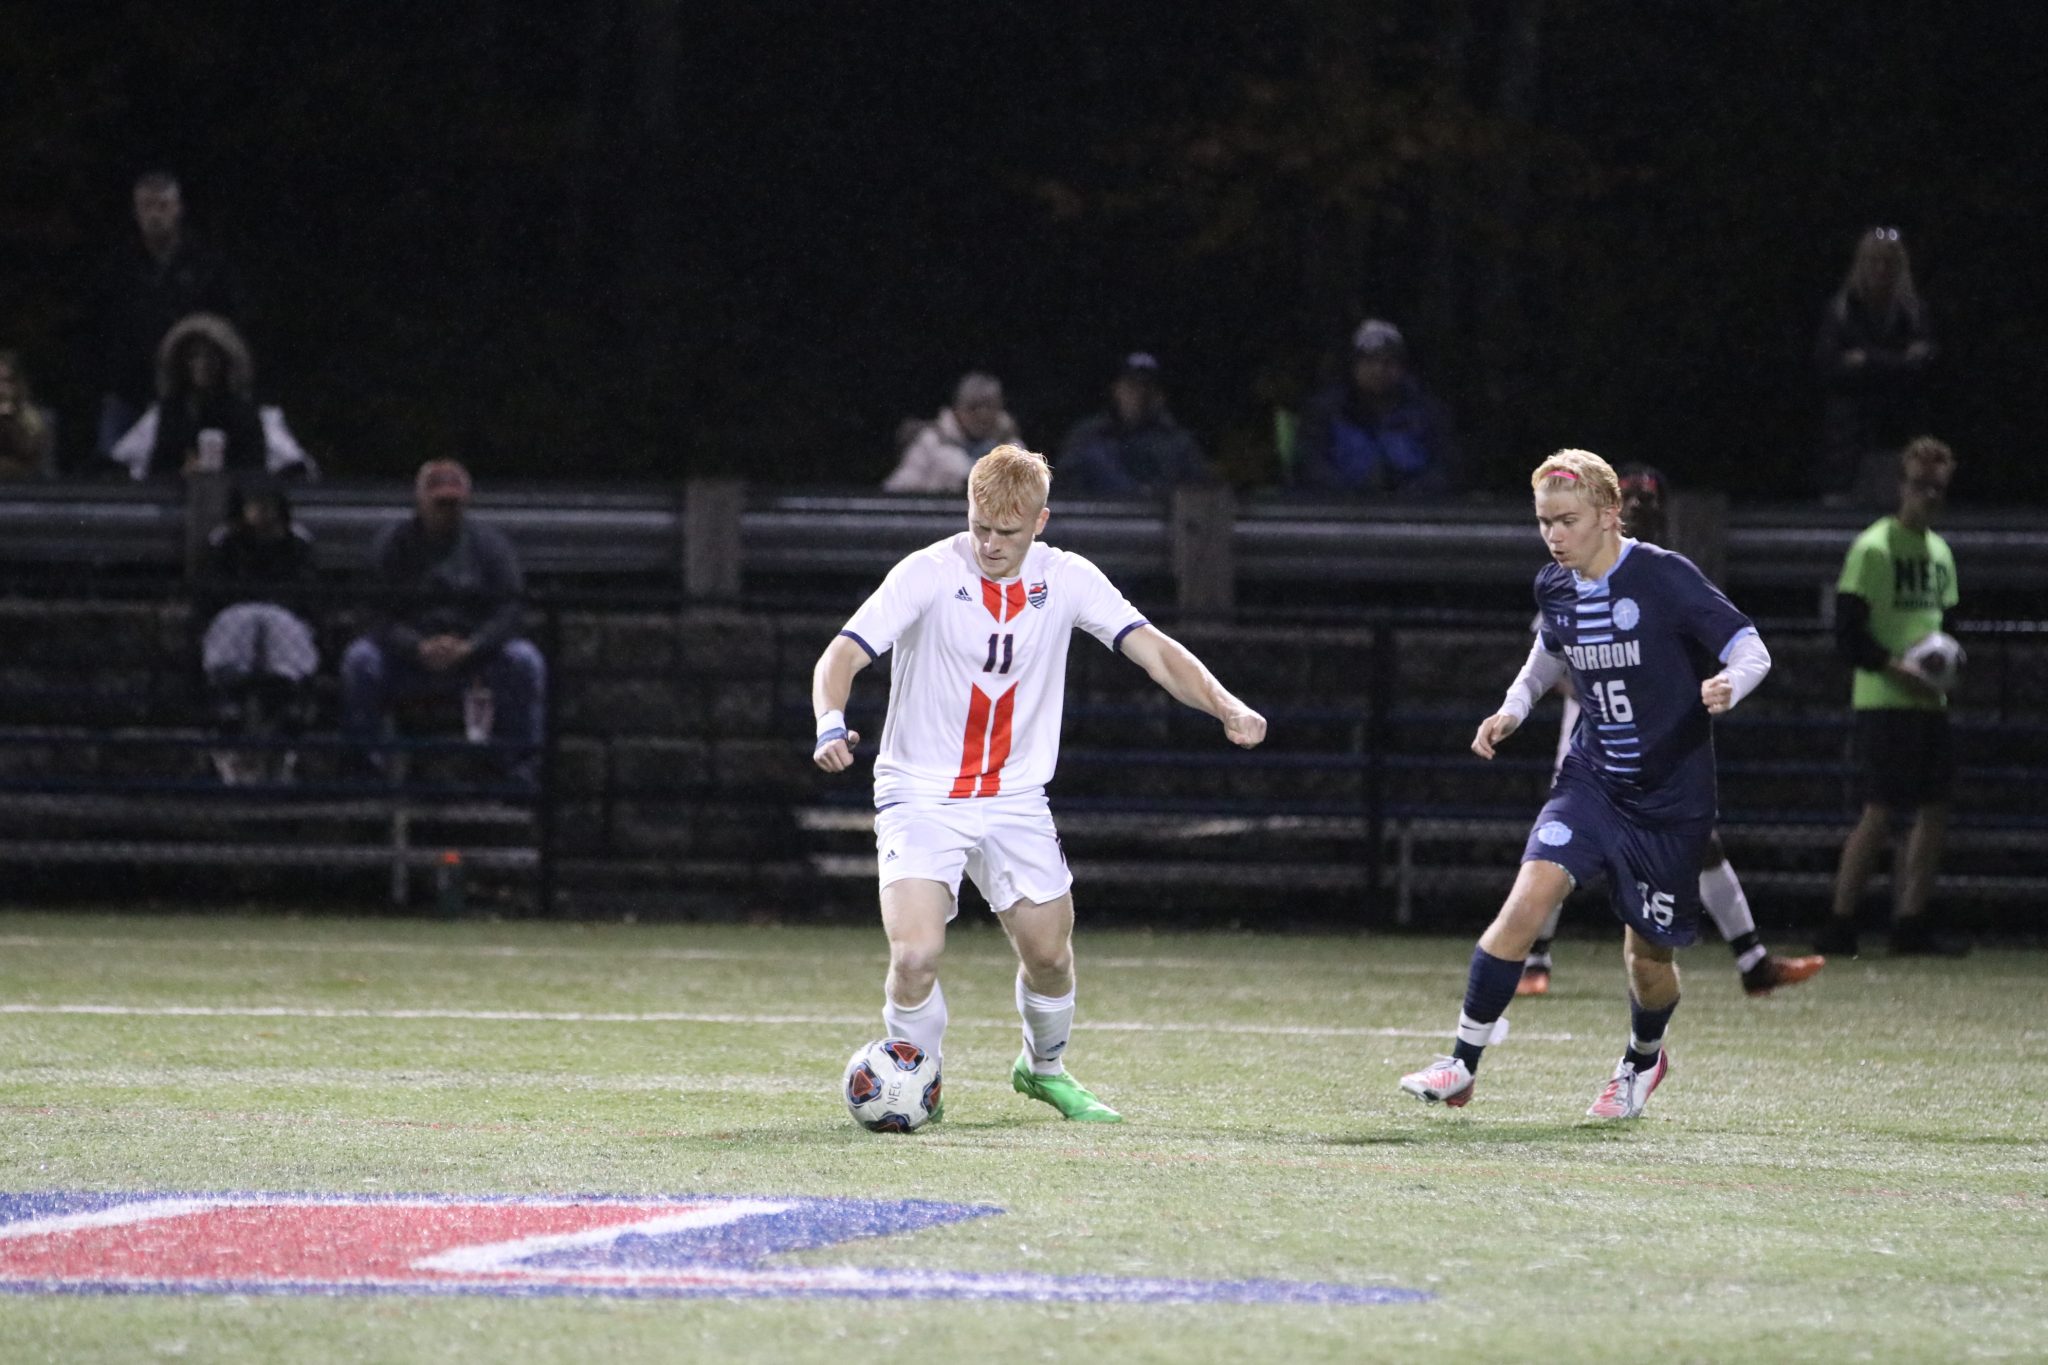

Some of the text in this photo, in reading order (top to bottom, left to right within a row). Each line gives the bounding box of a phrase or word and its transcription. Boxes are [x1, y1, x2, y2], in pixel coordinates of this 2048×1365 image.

[983, 633, 1014, 674] 11
[1563, 640, 1641, 671] GORDON
[1592, 680, 1633, 723] 16
[1636, 881, 1675, 927] 16
